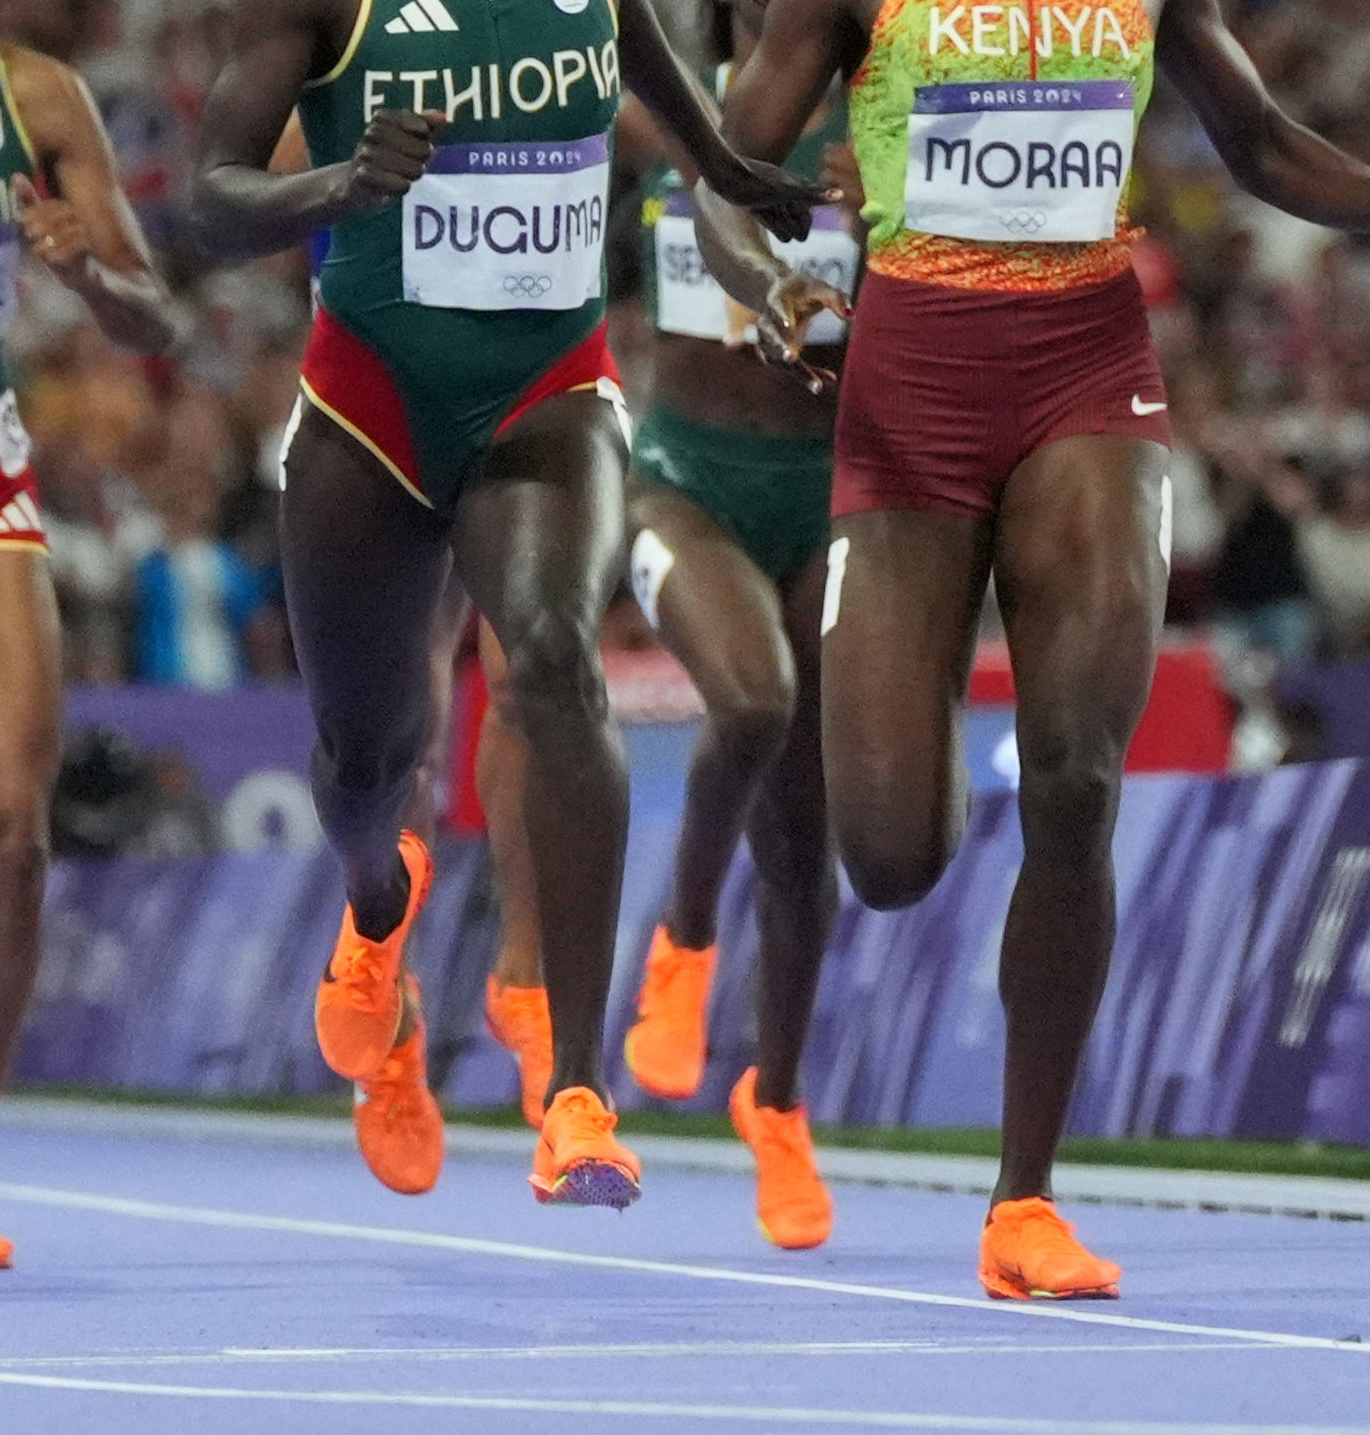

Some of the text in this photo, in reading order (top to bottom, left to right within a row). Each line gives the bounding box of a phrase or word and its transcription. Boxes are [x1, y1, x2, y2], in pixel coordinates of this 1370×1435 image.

[929, 5, 1131, 59] KENYA
[363, 39, 621, 123] ETHIOPIA
[969, 90, 1026, 105] PARIS
[469, 150, 581, 166] PARIS 2024
[925, 137, 1123, 189] MORAA
[414, 195, 602, 254] DUGUMA
